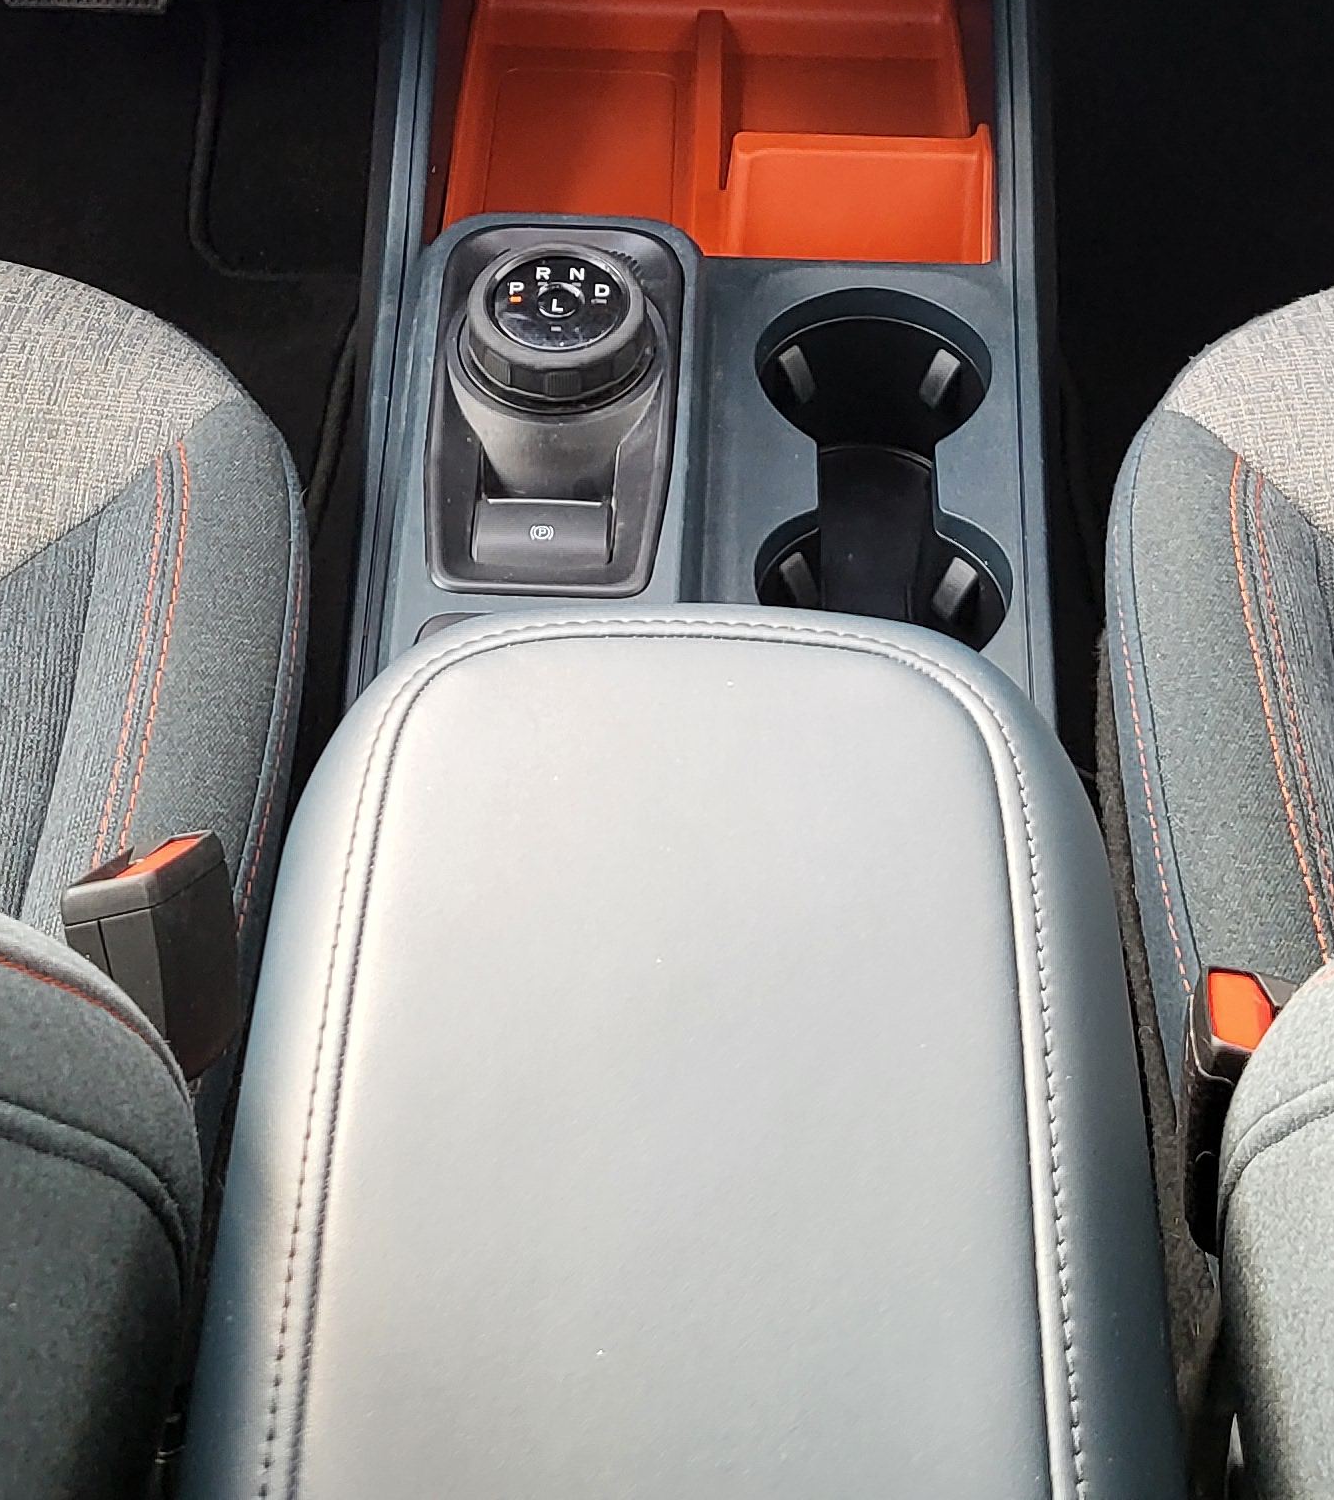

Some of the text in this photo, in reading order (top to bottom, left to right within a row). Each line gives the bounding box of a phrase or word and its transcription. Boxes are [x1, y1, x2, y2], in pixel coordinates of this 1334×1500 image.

[535, 266, 552, 281] R
[569, 267, 586, 281] N
[509, 282, 525, 295] P
[594, 284, 610, 298] D
[551, 299, 564, 313] L
